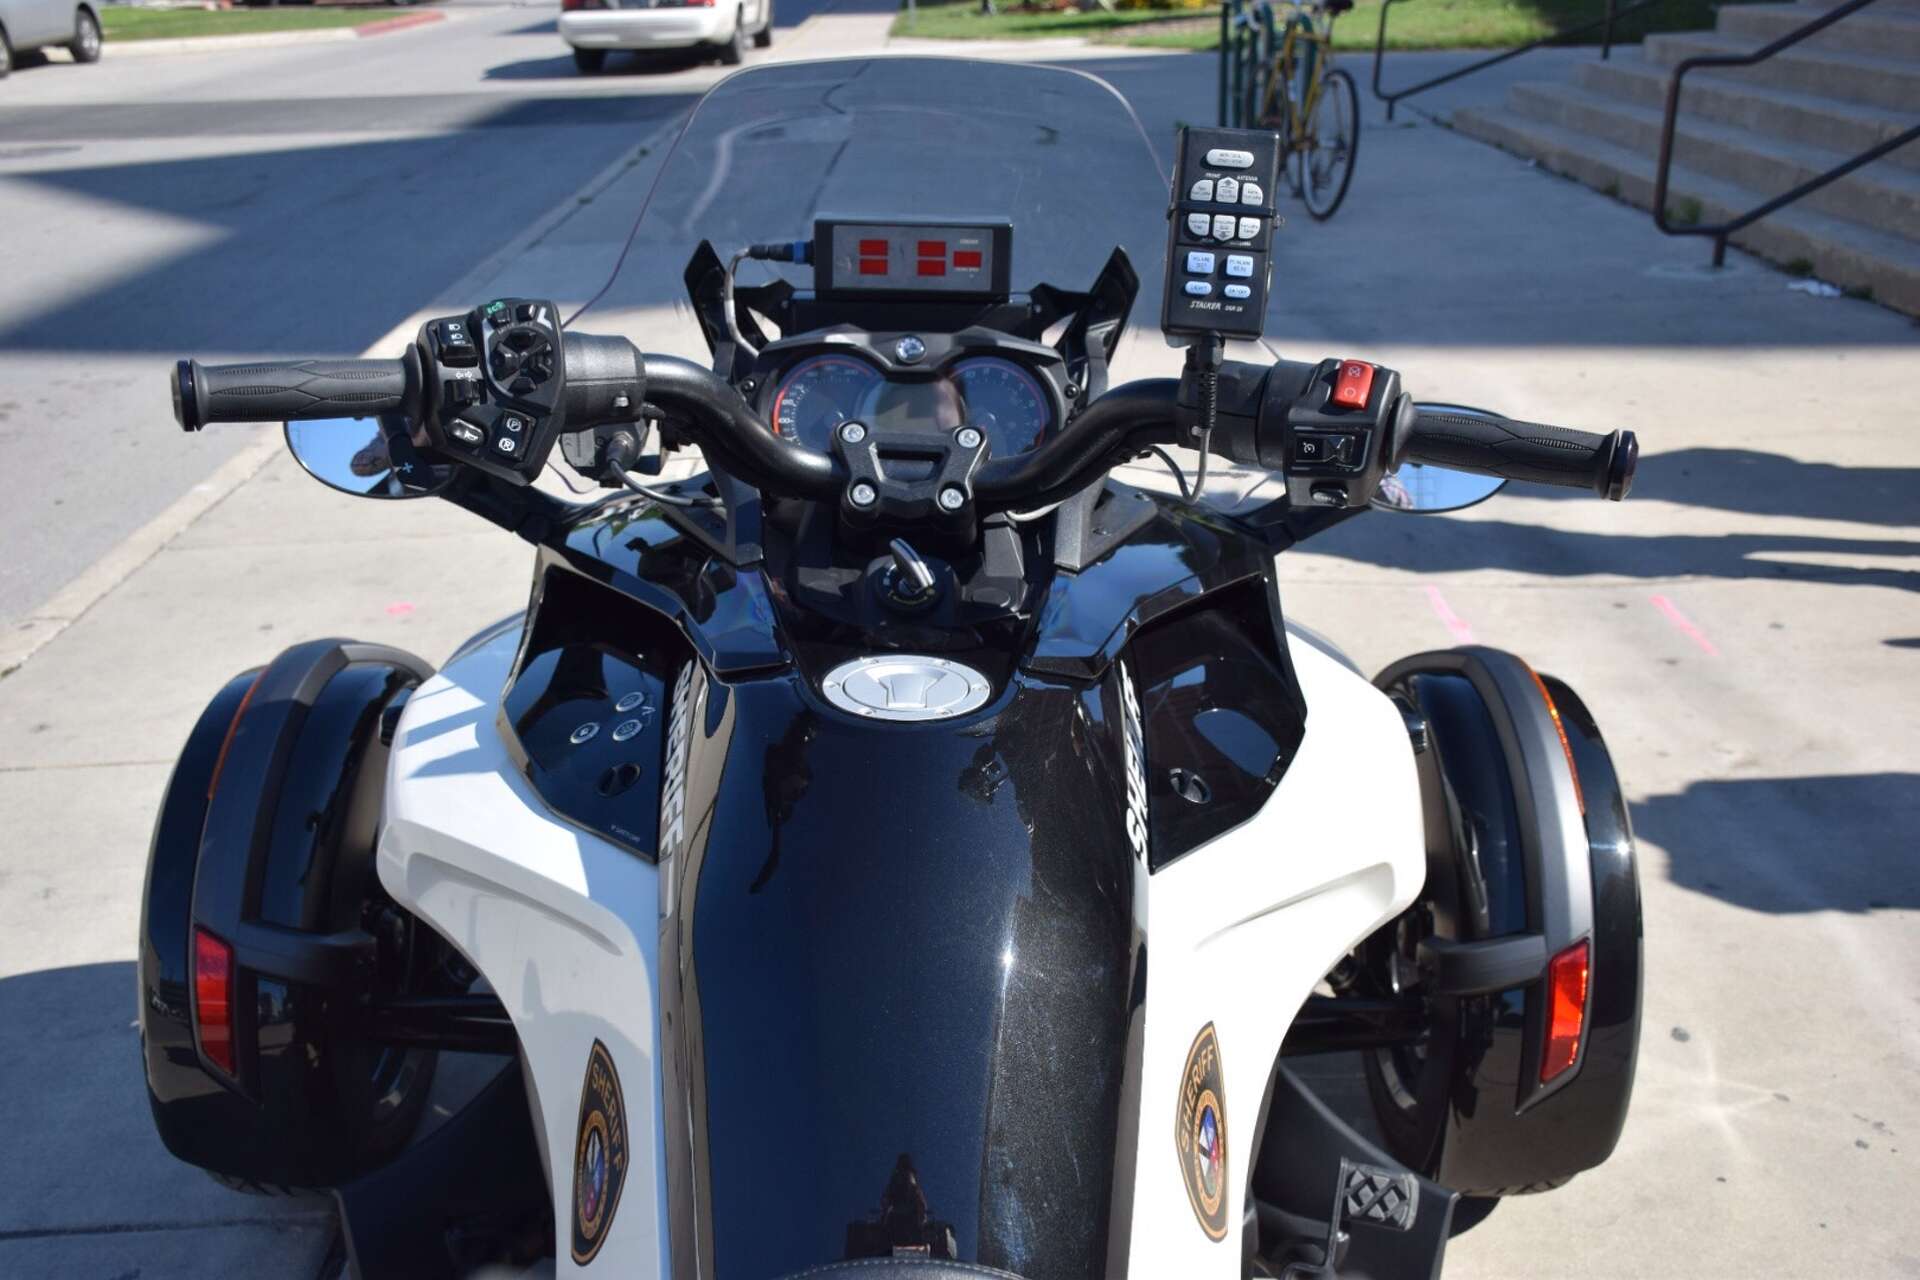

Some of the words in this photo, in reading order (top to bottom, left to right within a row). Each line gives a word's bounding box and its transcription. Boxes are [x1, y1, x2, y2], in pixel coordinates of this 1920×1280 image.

[1190, 300, 1222, 311] STALKER
[659, 659, 693, 856] SHERIFF
[591, 1062, 622, 1170] SHERIFF
[1182, 1045, 1214, 1152] SHERIFF
